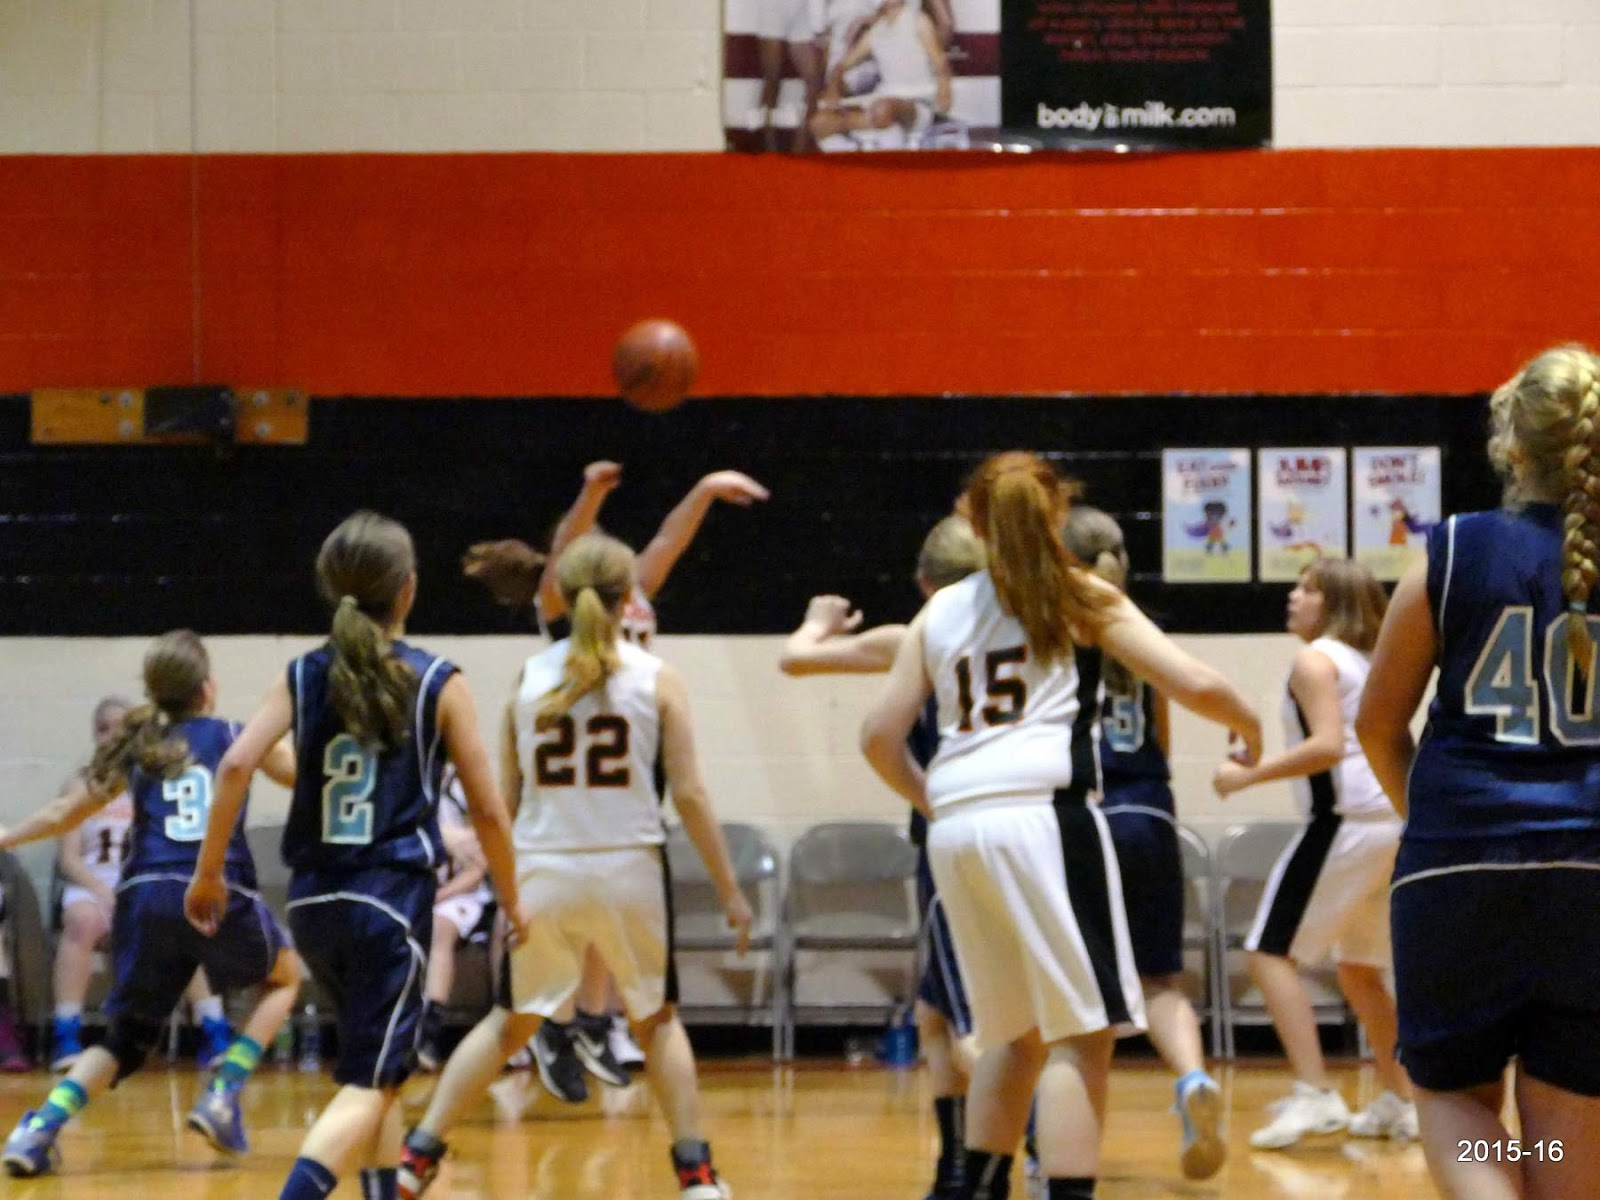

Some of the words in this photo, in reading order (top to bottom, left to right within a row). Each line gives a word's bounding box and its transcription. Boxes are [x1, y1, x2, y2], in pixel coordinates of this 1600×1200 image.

[955, 645, 1027, 732] 15
[1464, 605, 1600, 747] 40
[322, 734, 377, 845] 2
[534, 713, 630, 788] 22
[162, 765, 213, 842] 3
